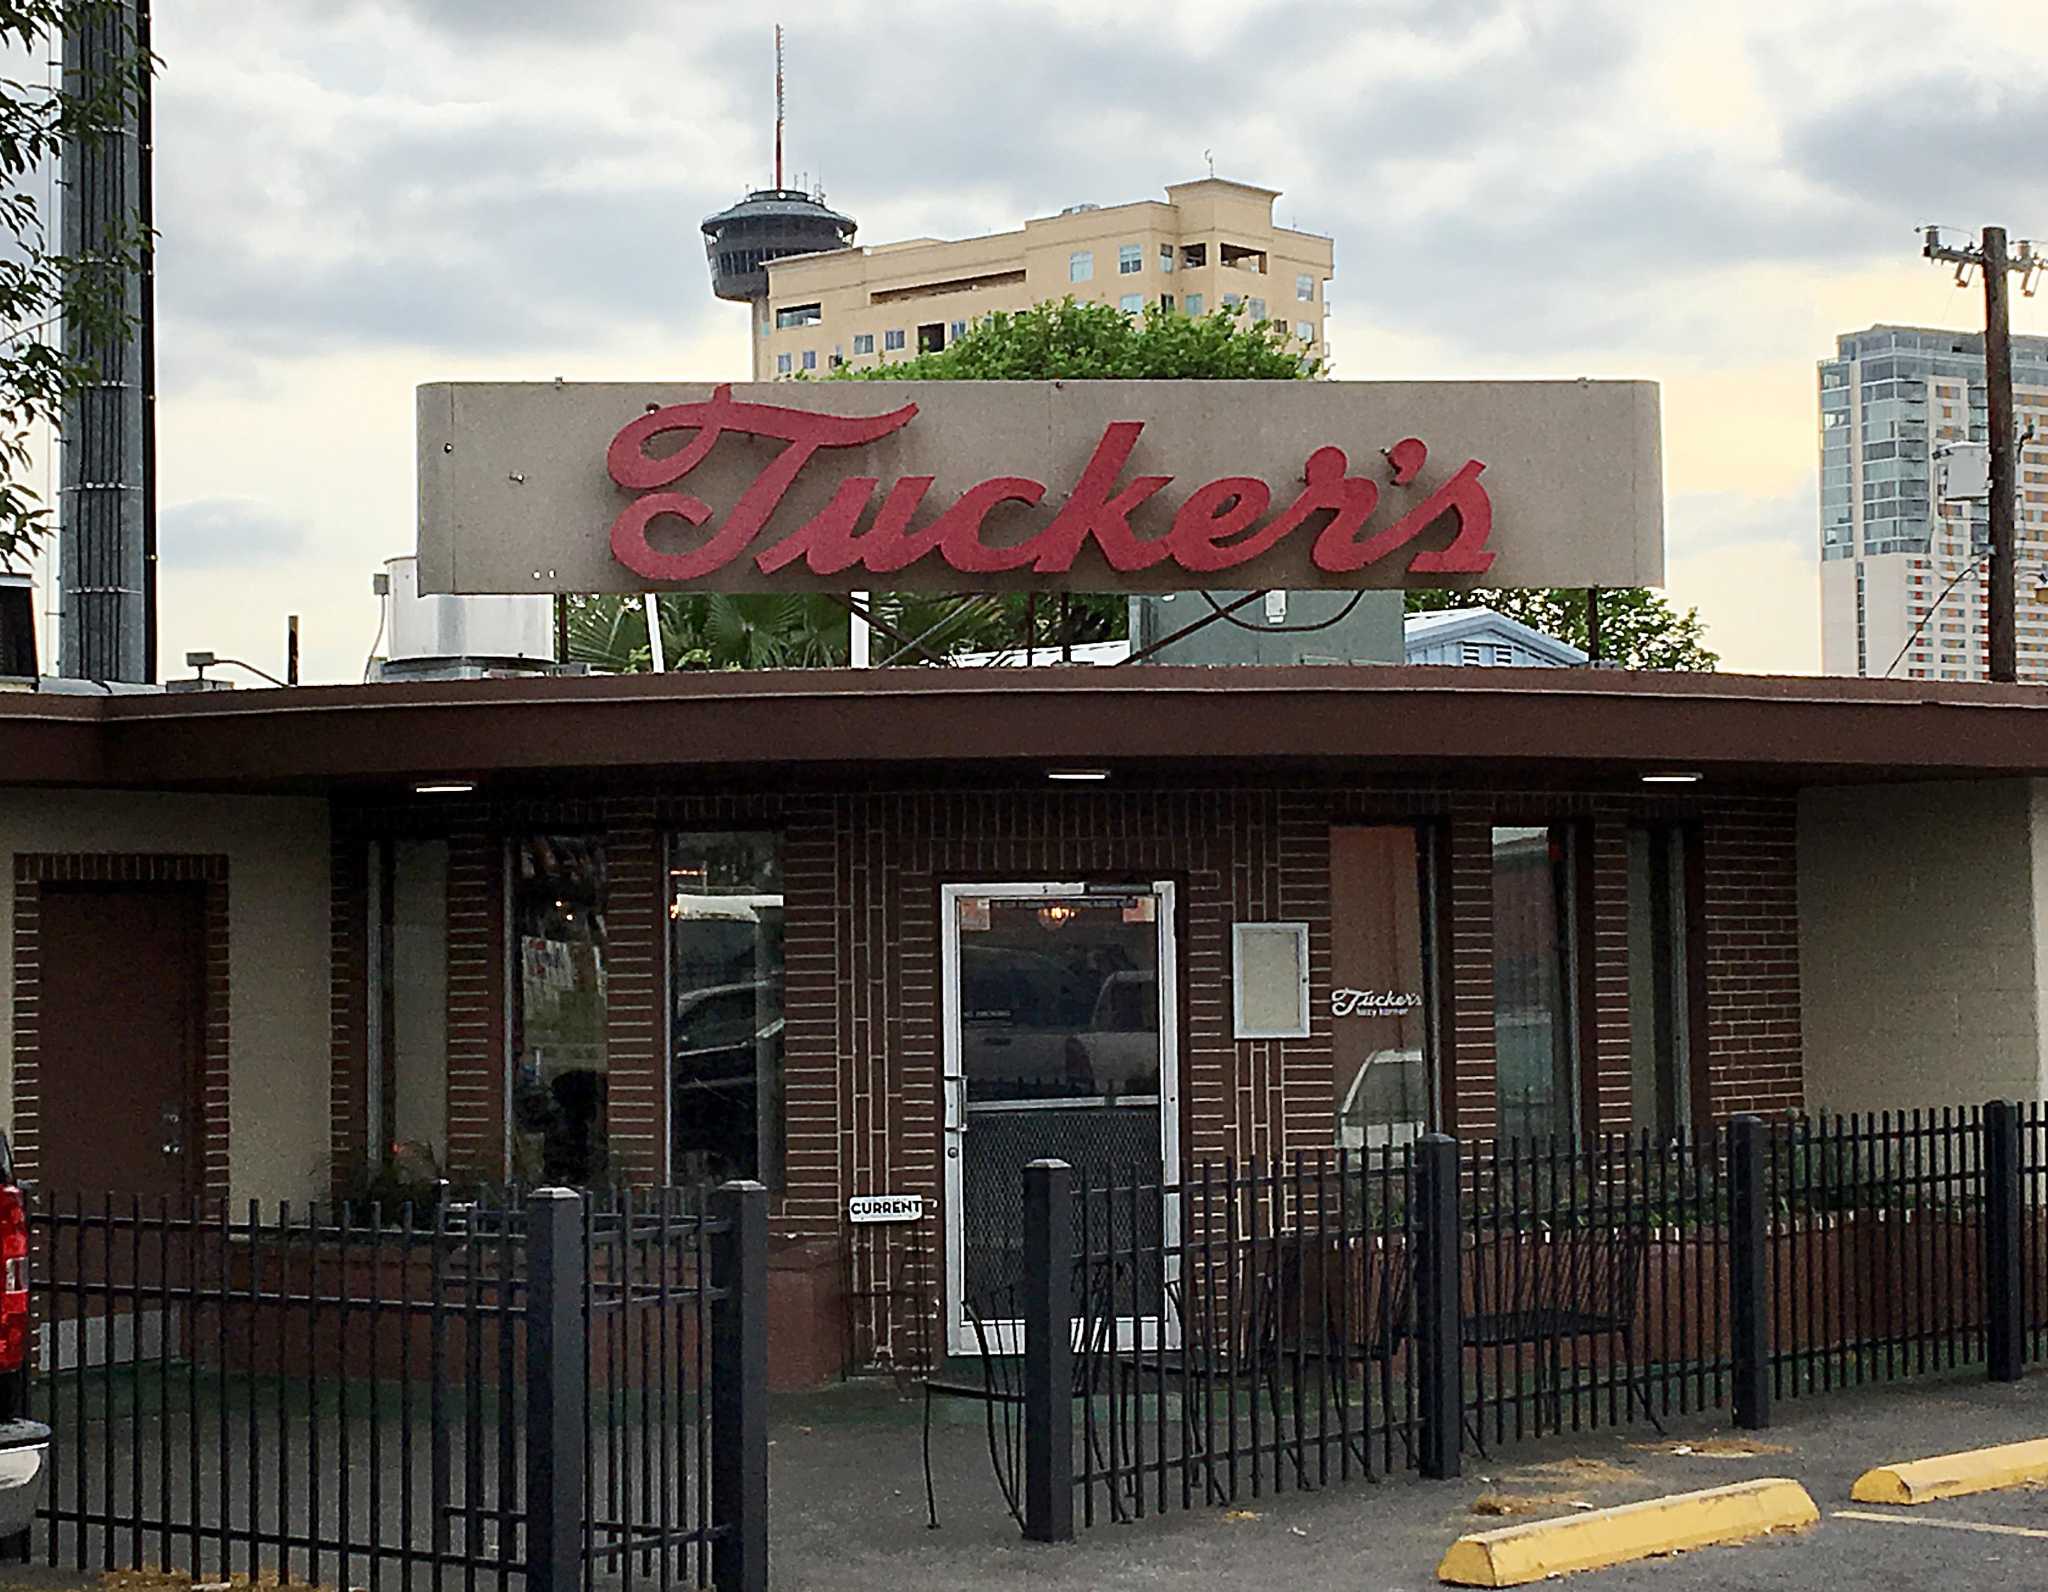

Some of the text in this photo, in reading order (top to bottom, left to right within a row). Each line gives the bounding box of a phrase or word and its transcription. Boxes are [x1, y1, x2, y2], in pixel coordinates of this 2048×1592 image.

[607, 384, 1495, 581] Tucker's
[1331, 987, 1422, 1016] Tucker's
[850, 1201, 923, 1215] CURRENT
